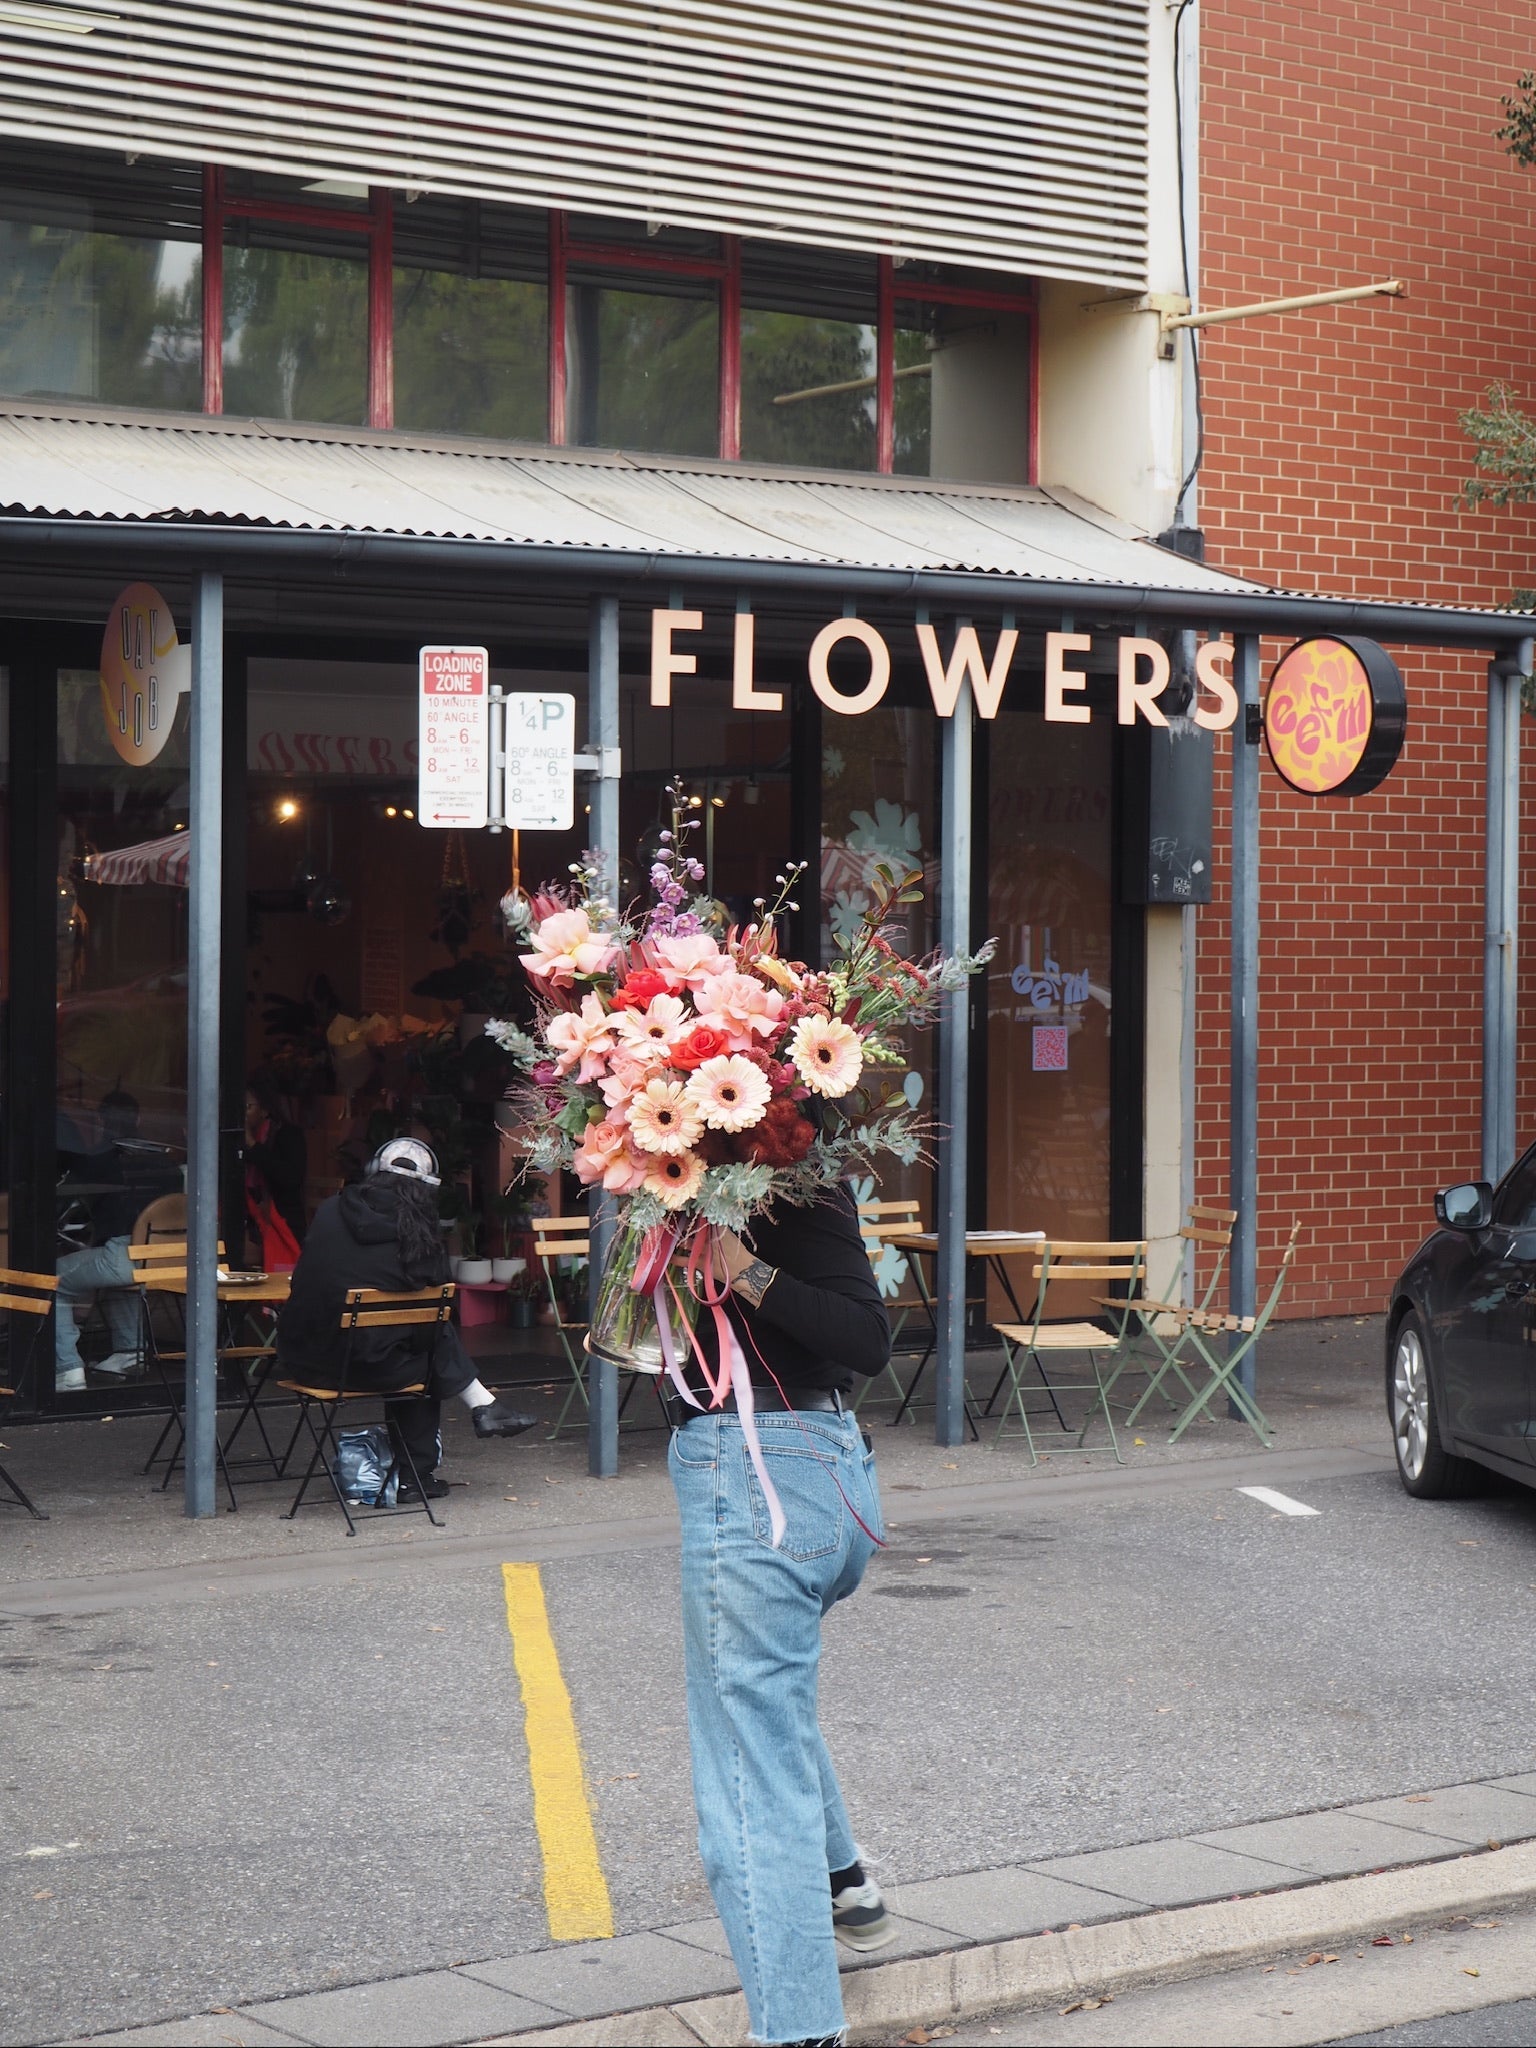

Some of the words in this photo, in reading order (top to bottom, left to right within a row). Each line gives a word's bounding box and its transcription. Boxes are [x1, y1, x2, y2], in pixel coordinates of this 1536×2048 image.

[122, 607, 158, 669] DAY
[425, 656, 482, 674] LOADING
[650, 608, 1239, 730] FLOWERS
[436, 674, 472, 692] ZONE
[428, 698, 440, 708] 10
[442, 698, 478, 708] MINUTE
[119, 676, 158, 747] JOB
[444, 712, 479, 723] ANGLE
[427, 728, 437, 744] 8
[459, 728, 469, 744] 6
[532, 748, 568, 759] ANGLE
[428, 758, 437, 773] 8
[464, 758, 478, 768] 12
[511, 760, 520, 776] 8
[547, 760, 558, 776] 6
[446, 776, 461, 784] SAT
[512, 788, 522, 804] 8
[552, 789, 565, 800] 12
